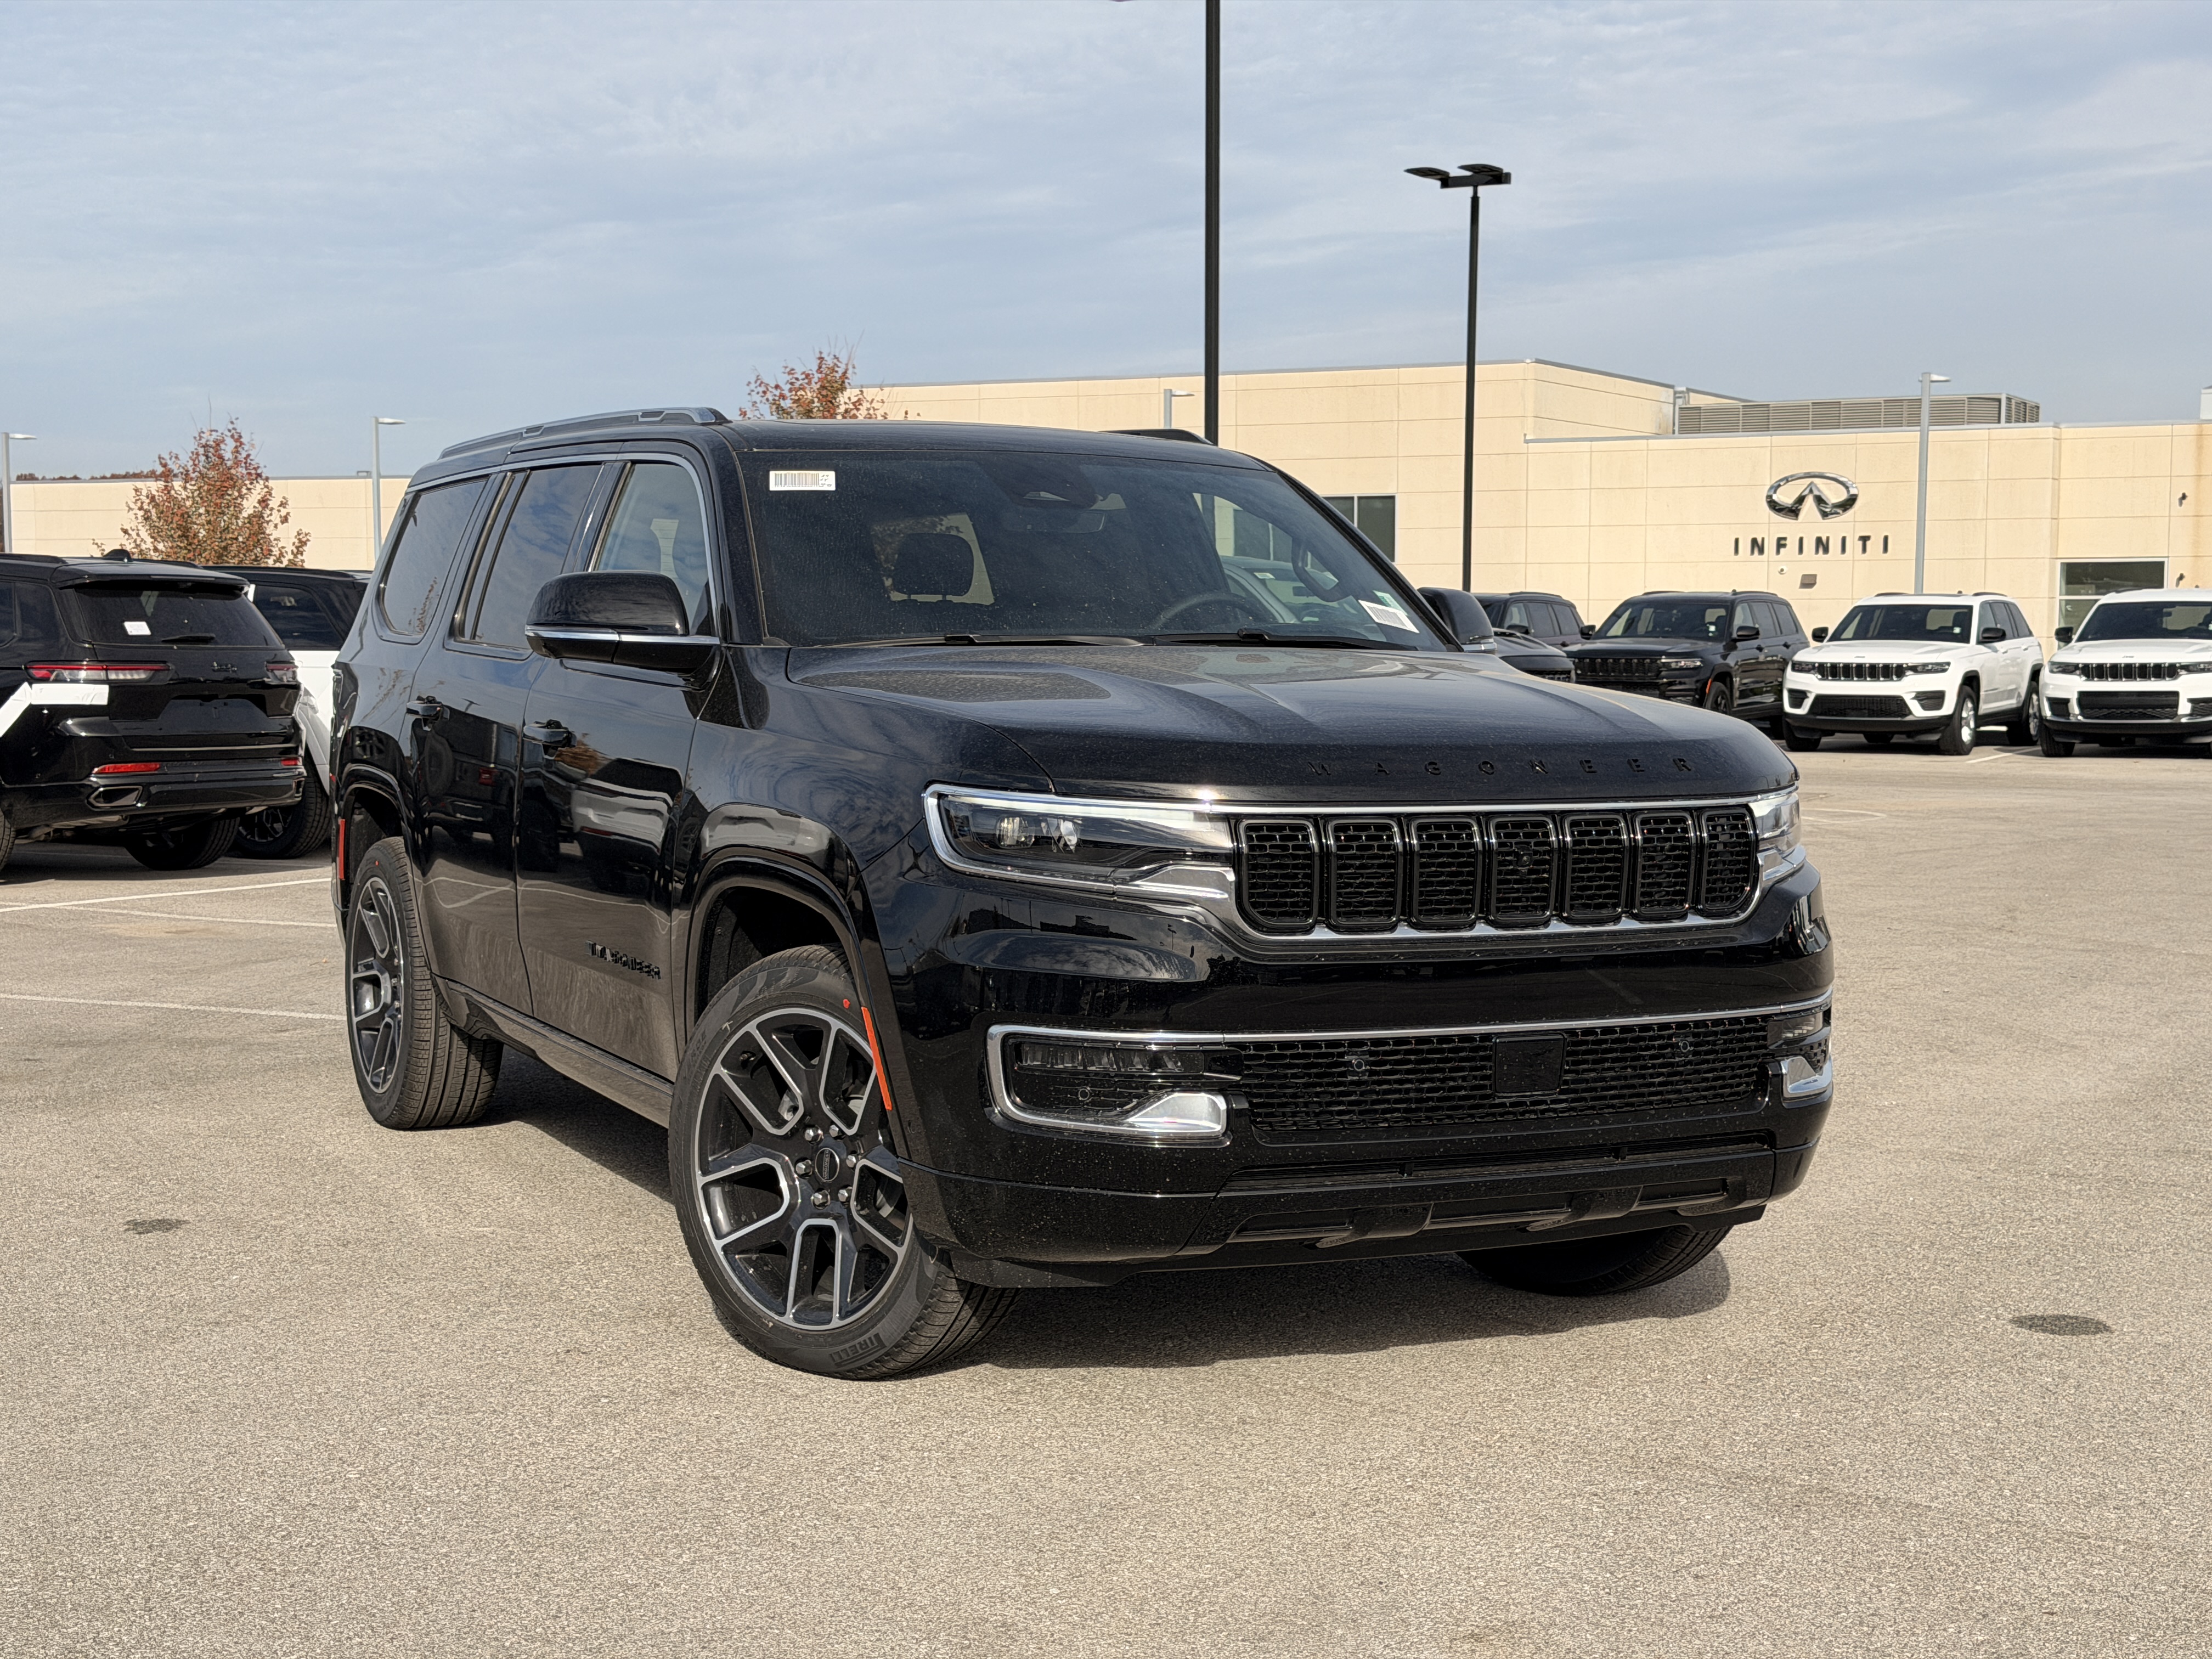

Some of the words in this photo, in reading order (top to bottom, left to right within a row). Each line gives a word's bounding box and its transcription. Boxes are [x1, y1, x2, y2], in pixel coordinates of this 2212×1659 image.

[1734, 535, 1889, 556] INFINITI
[1307, 758, 1692, 776] WAGONEER
[830, 1333, 887, 1368] PIRELLI
